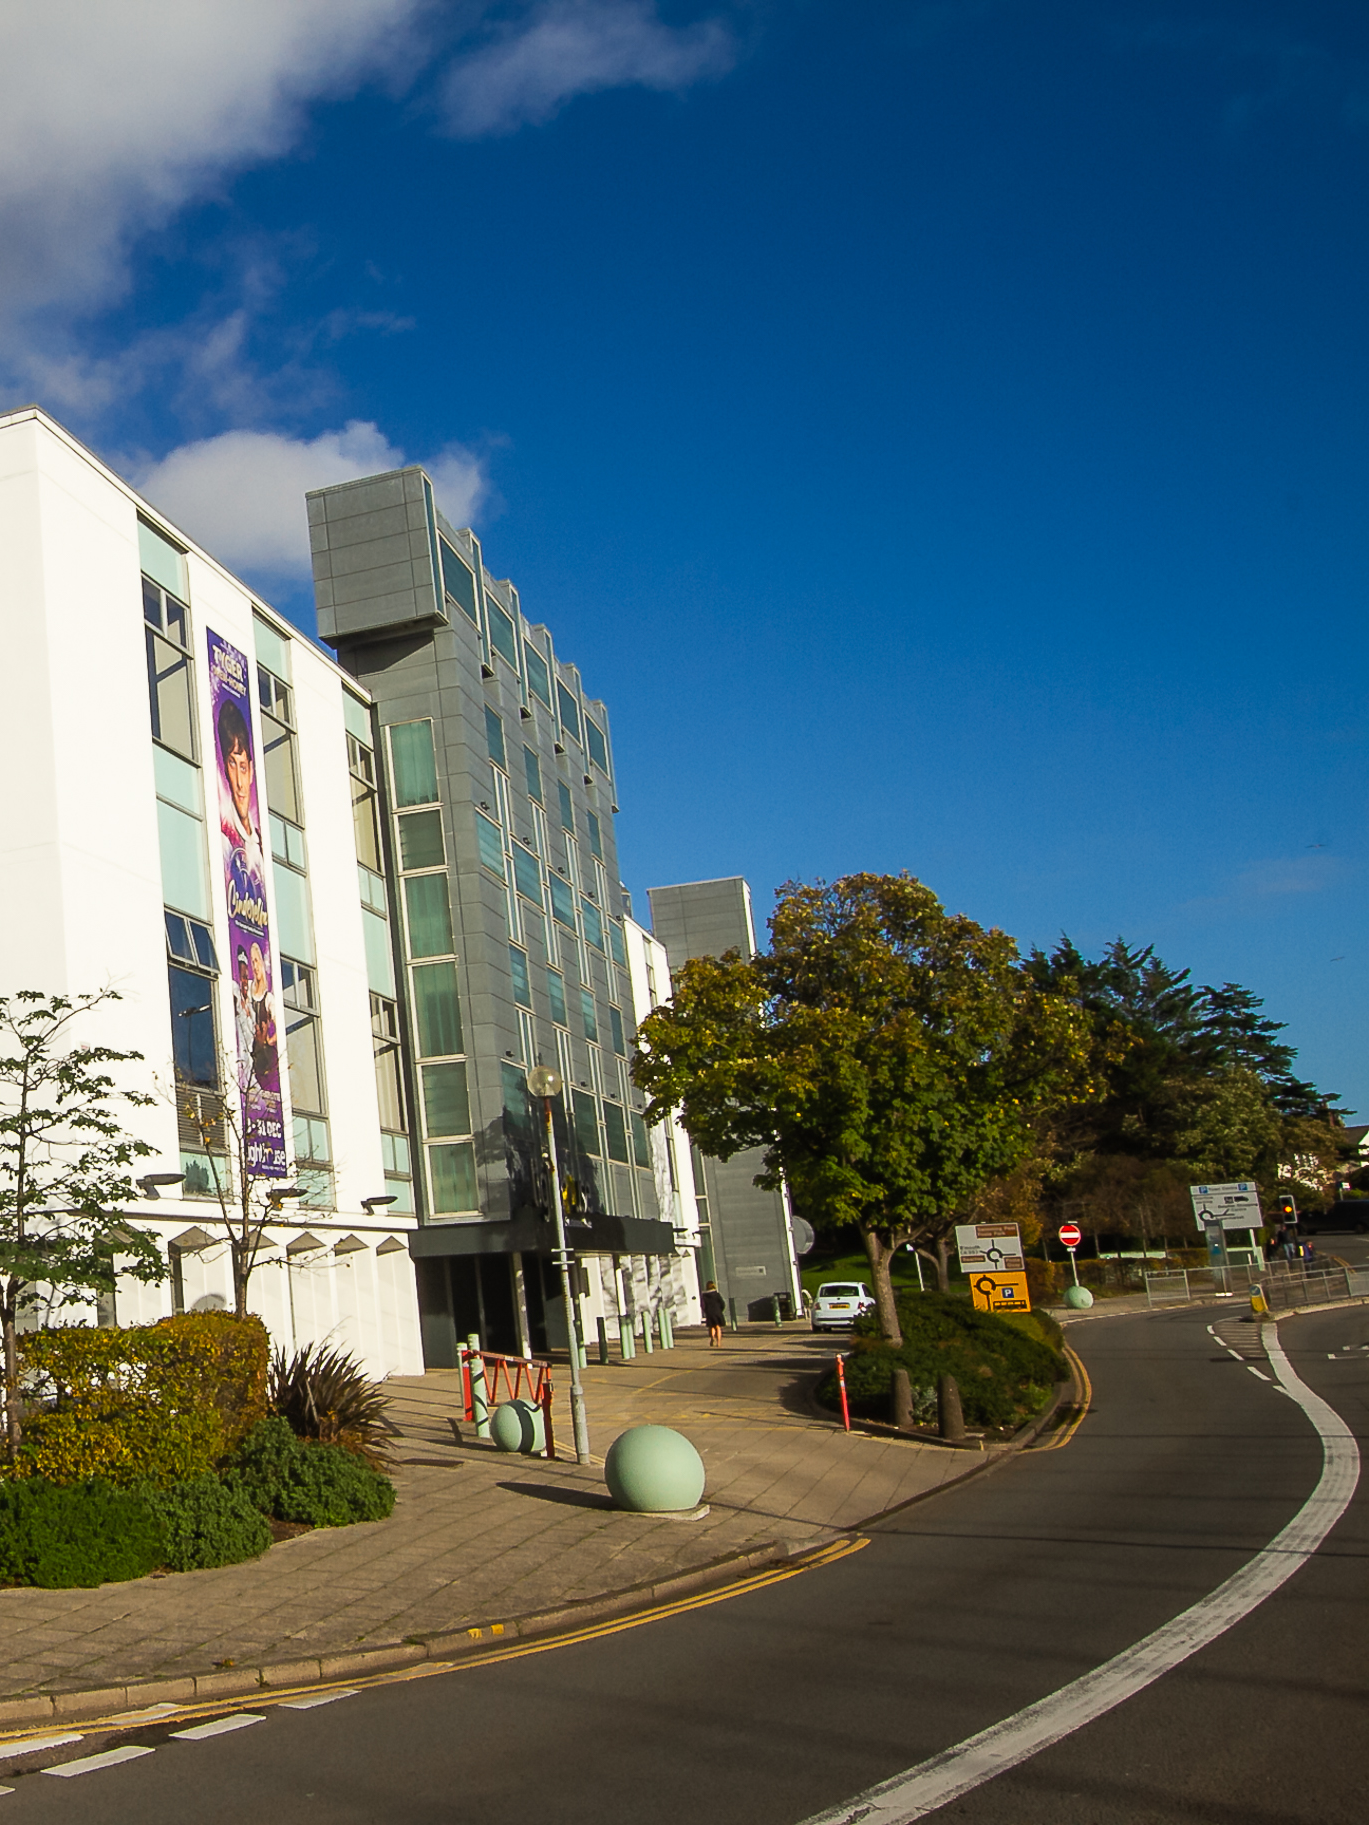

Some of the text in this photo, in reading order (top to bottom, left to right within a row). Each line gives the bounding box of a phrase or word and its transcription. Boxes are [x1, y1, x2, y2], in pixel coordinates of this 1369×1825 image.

[212, 644, 244, 682] TYGER
[266, 1121, 282, 1138] DEC
[1004, 1289, 1012, 1297] P
